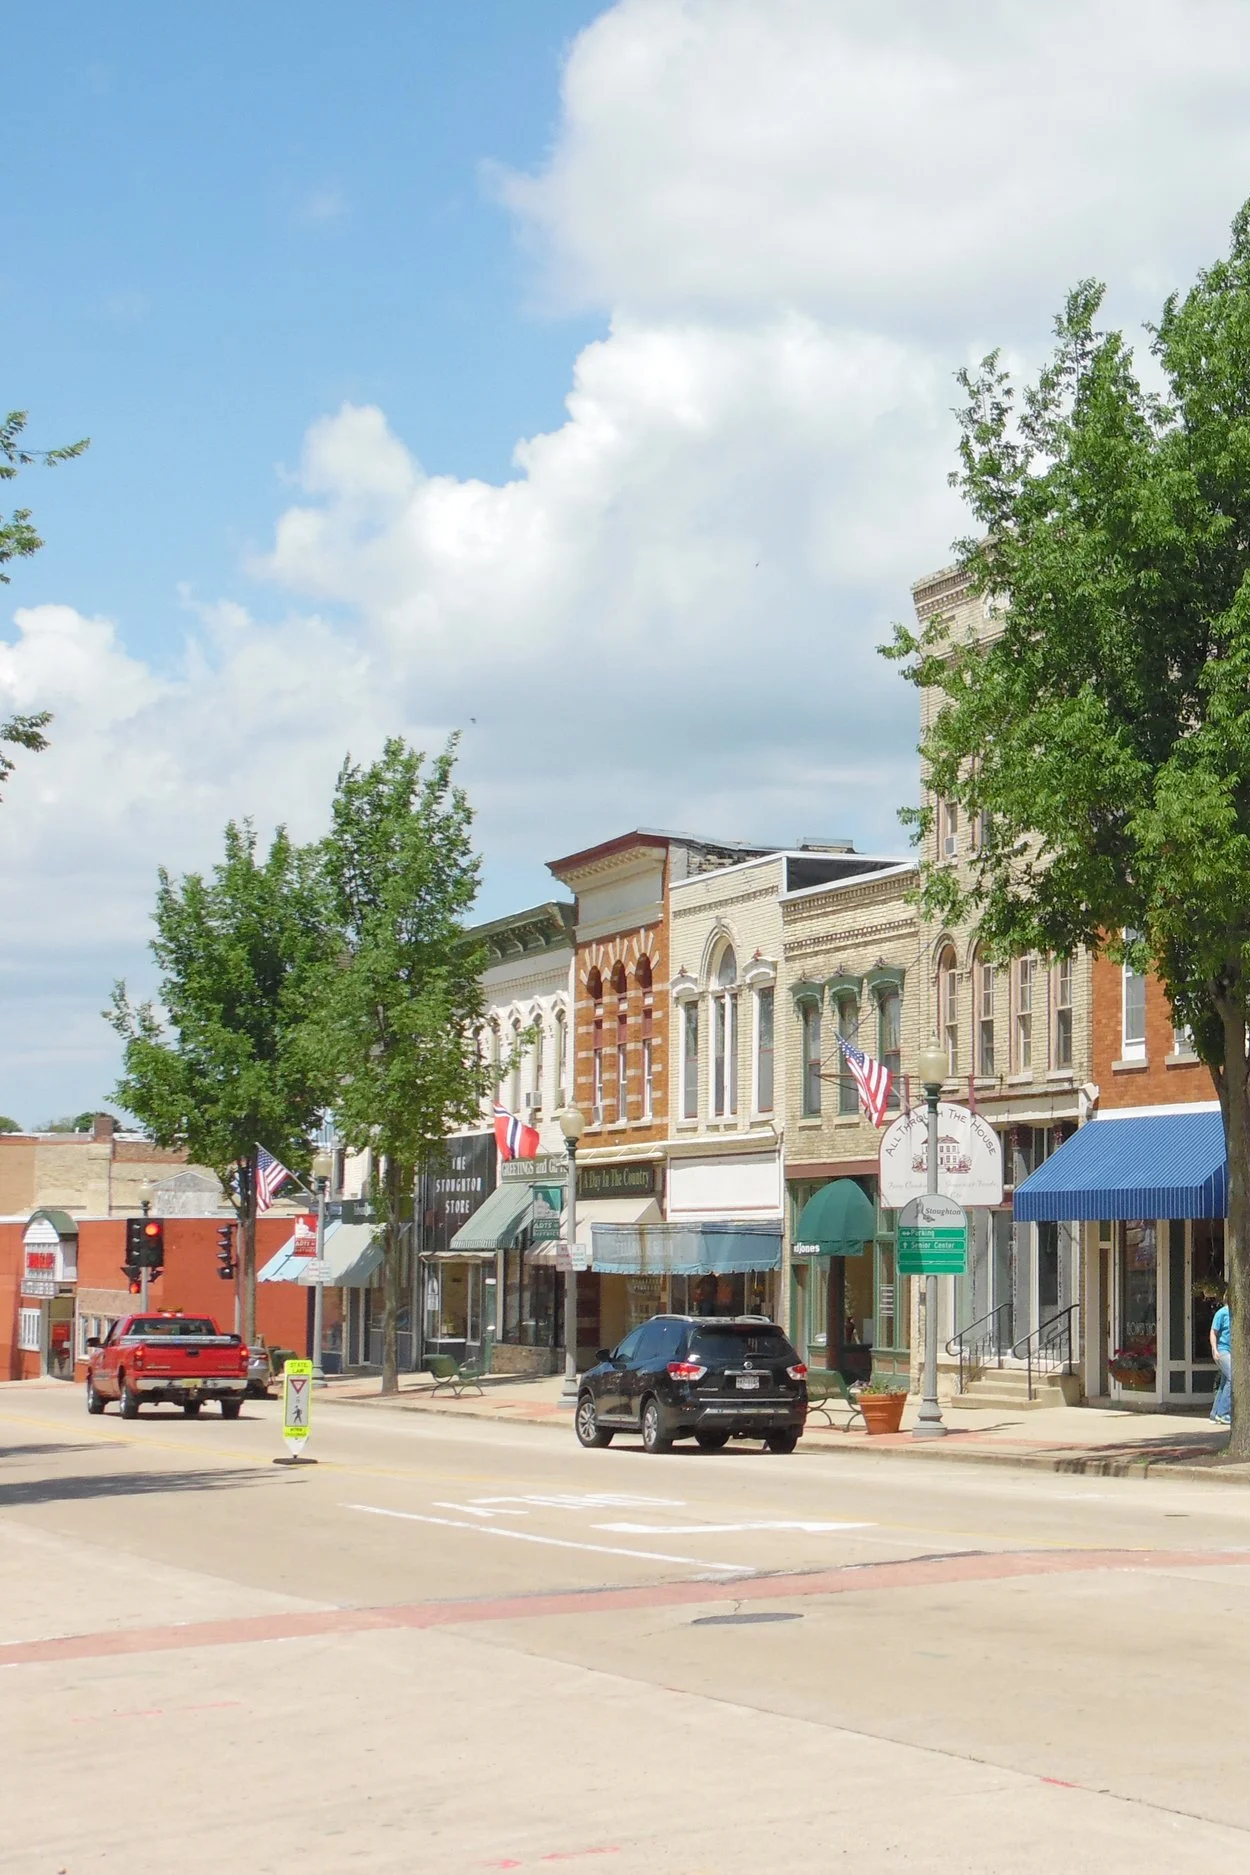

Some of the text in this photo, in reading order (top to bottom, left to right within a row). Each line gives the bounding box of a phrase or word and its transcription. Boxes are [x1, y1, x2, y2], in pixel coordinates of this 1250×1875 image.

[886, 1108, 997, 1157] ALL THROUH THE HOUSE
[502, 1161, 534, 1177] GREETINGS
[535, 1159, 548, 1174] and
[435, 1177, 482, 1192] STOUGHTON
[583, 1167, 650, 1191] A Day In The Country
[445, 1200, 470, 1213] STORE
[925, 1208, 961, 1216] Stoughton
[911, 1229, 935, 1238] Parking
[934, 1241, 955, 1249] Center
